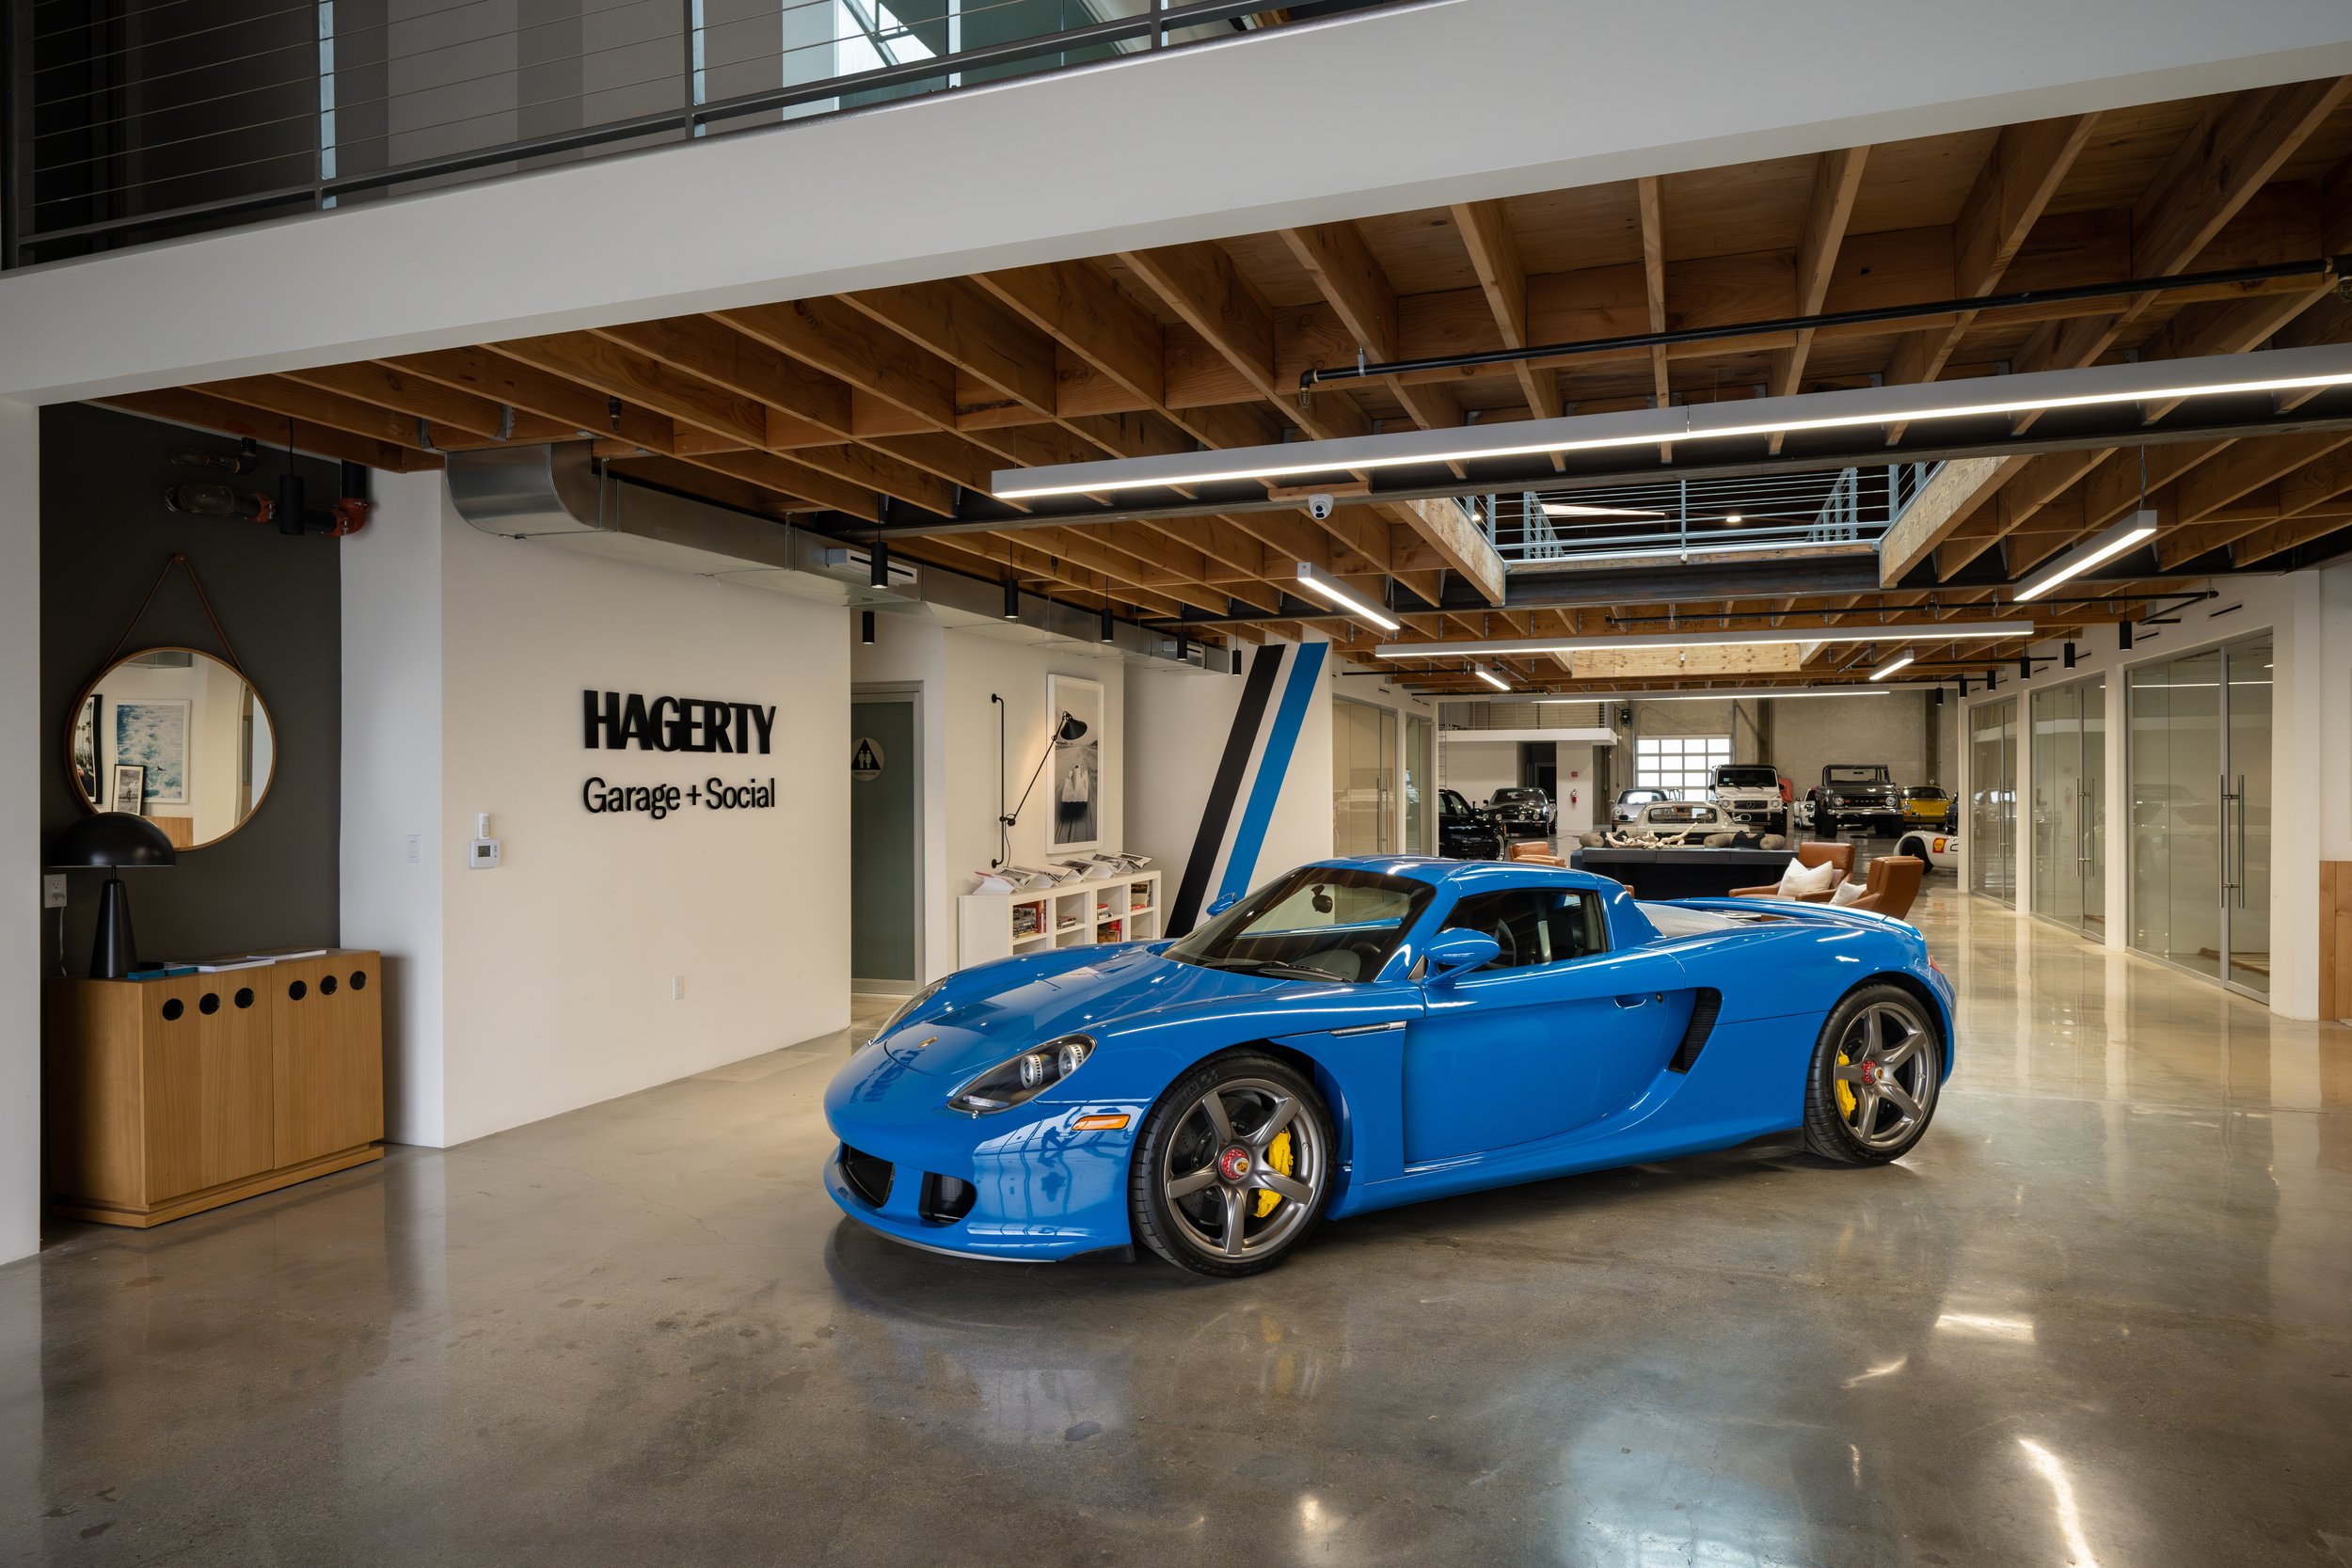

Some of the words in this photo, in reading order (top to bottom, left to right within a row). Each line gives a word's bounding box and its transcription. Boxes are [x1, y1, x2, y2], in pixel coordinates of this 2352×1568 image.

[583, 689, 777, 754] HAGERTY
[582, 776, 681, 820] Garage
[686, 784, 703, 806] +
[706, 777, 775, 810] Social
